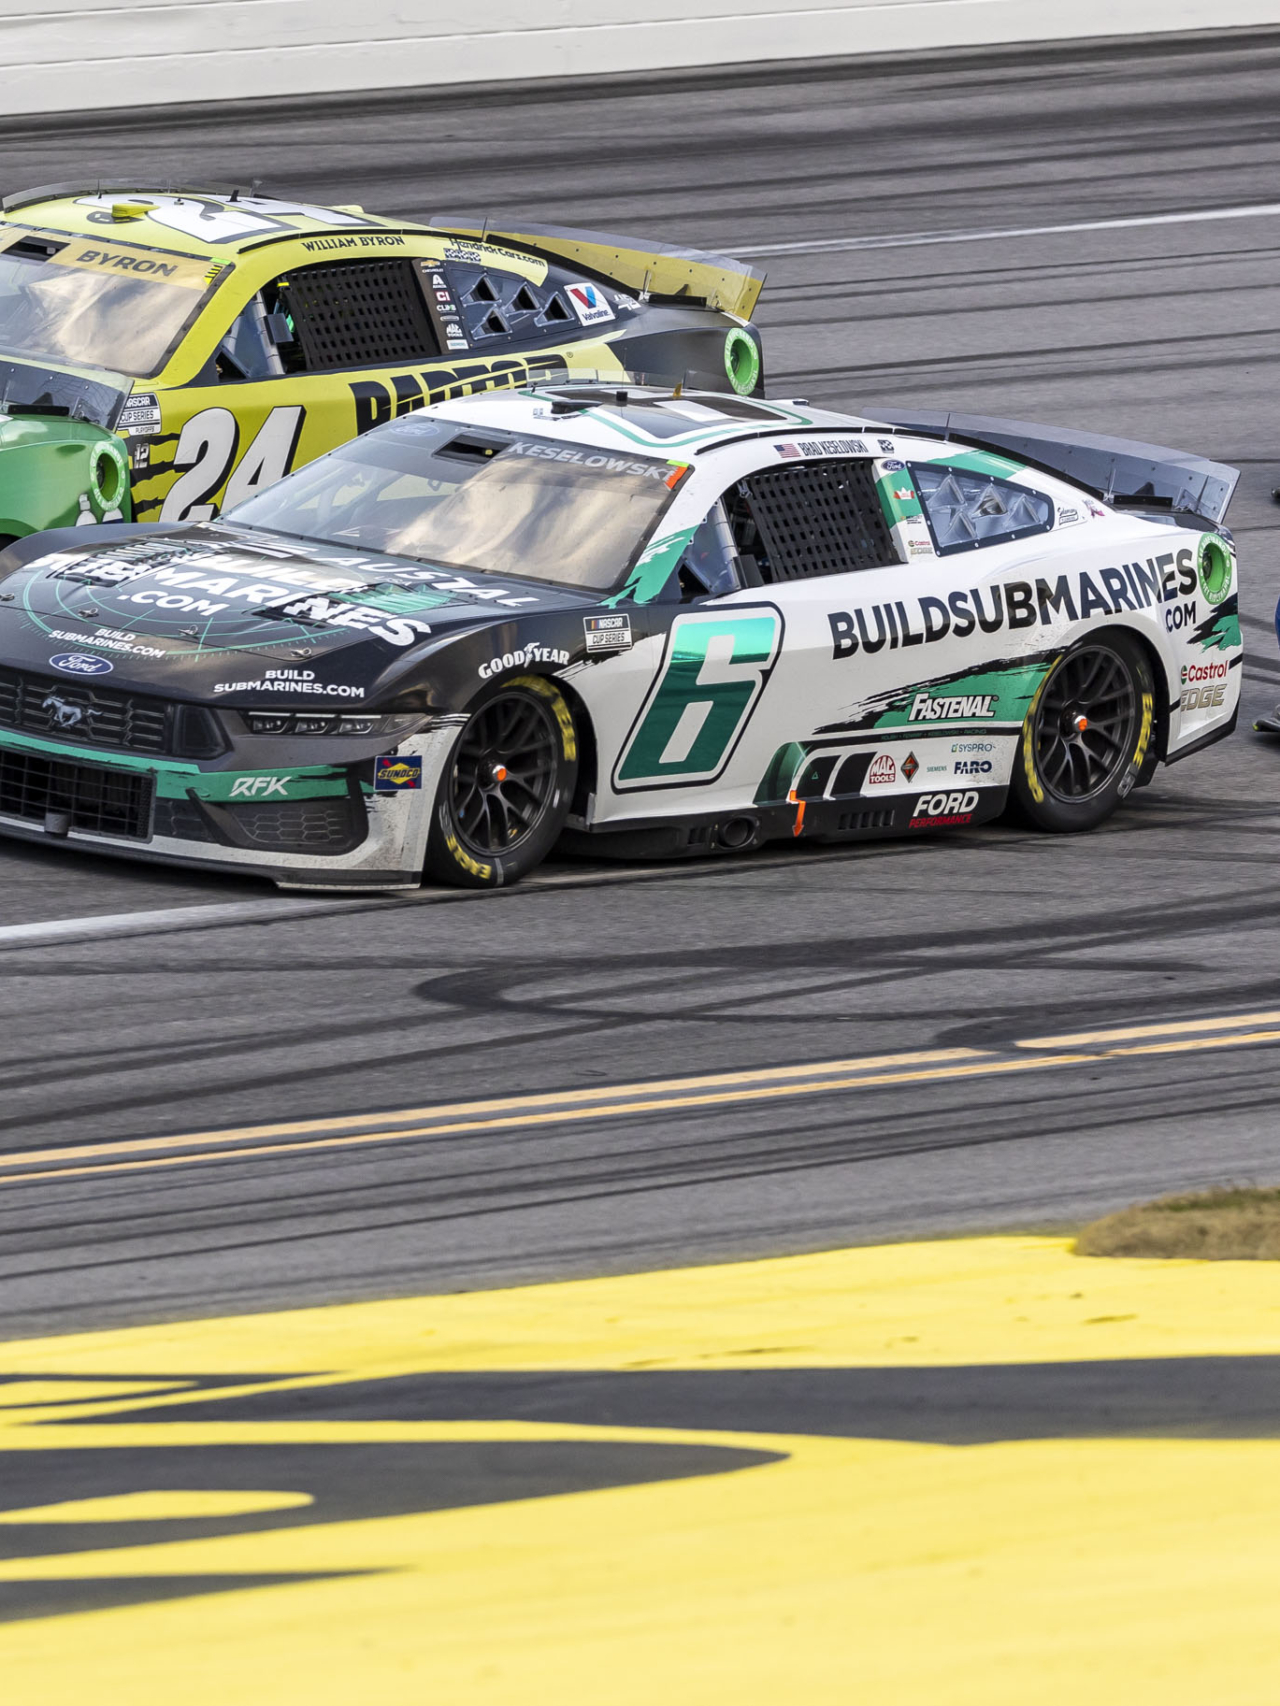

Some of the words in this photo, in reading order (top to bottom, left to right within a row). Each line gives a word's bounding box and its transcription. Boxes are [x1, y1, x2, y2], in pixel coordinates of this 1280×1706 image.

[301, 237, 358, 252] WILLIAM
[358, 236, 405, 247] BYRON
[76, 250, 178, 277] BYRON
[133, 410, 154, 421] SERIES
[797, 442, 823, 456] BRAD
[818, 439, 869, 455] KESELOWSKI
[157, 405, 306, 523] 24
[313, 557, 541, 608] AUSTAL
[117, 591, 230, 617] .COM
[828, 549, 1198, 660] BUILDSUBMARINES
[599, 617, 624, 629] NASCAR
[94, 627, 137, 642] BUILD
[592, 634, 604, 644] CUP
[605, 632, 626, 643] SERIES
[48, 629, 167, 660] SUBMARINES.COM
[57, 655, 100, 673] Ford
[477, 642, 570, 680] GOODYEAR
[265, 669, 316, 681] BUILD
[1188, 660, 1229, 683] Castrol
[213, 680, 365, 699] SUBMARINES.COM
[617, 614, 778, 784] 6
[1180, 684, 1228, 712] EDGE
[908, 693, 996, 722] FASTENAL
[959, 743, 993, 753] SYSPRO
[378, 768, 421, 780] SUNOCO
[871, 757, 896, 776] MAC
[926, 765, 947, 773] SIEMENS
[953, 760, 993, 775] FARO
[228, 776, 292, 797] RFK
[870, 774, 895, 784] TOOLS
[912, 791, 979, 818] FORD
[909, 813, 973, 829] PERFORMANCE
